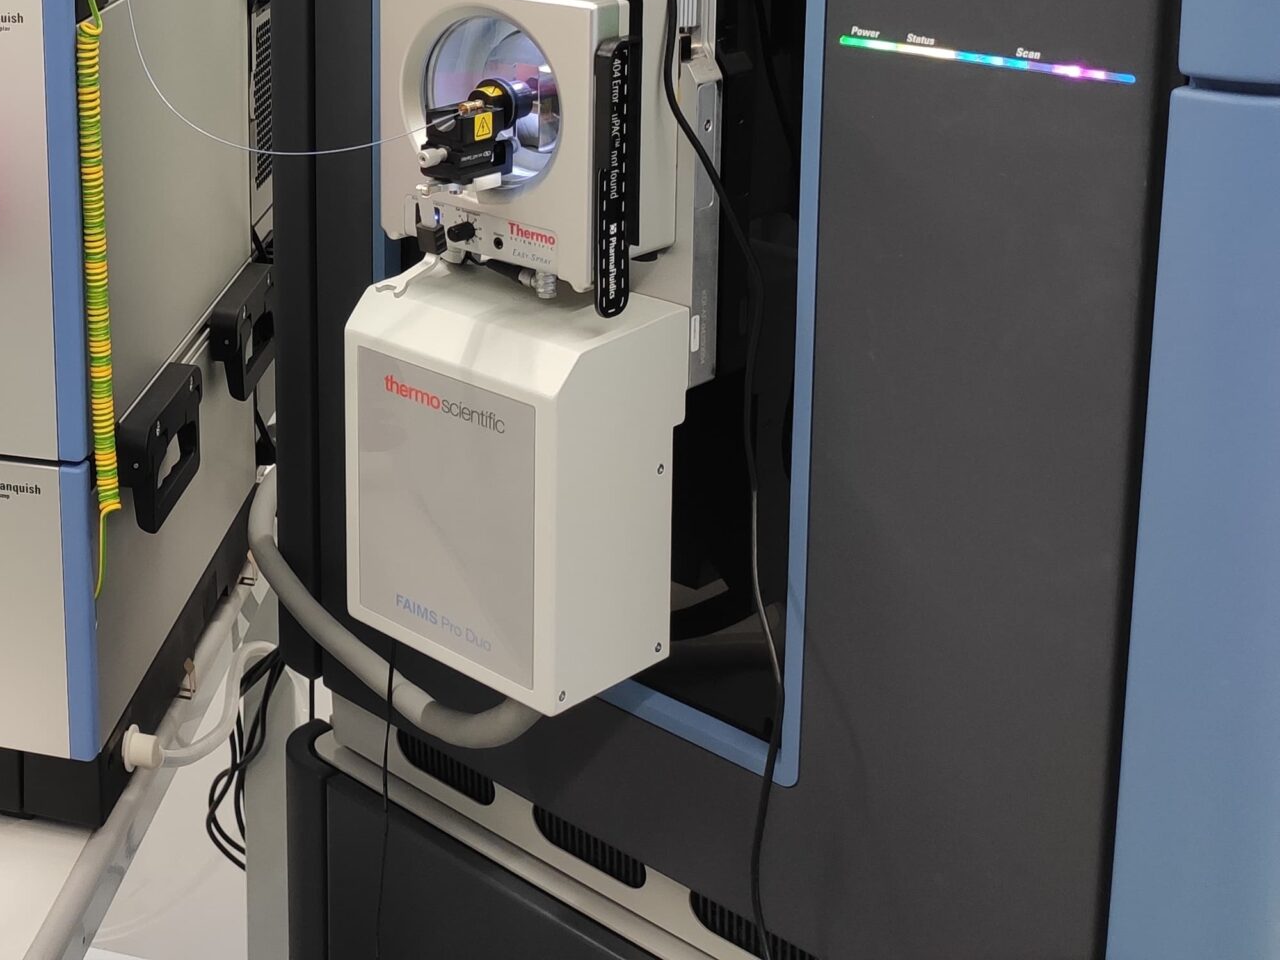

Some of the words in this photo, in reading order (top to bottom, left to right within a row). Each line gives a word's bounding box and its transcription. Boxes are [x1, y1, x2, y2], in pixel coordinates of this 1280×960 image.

[851, 26, 880, 38] Power
[906, 33, 935, 45] Status
[1015, 47, 1041, 60] Scan
[612, 58, 622, 77] 404
[611, 80, 621, 103] Error
[609, 169, 620, 200] found
[508, 222, 556, 246] Thermo
[608, 237, 617, 300] PharmaFluidics
[396, 593, 438, 625] FAIMS
[441, 616, 462, 637] Pro
[465, 628, 492, 652] Duo
